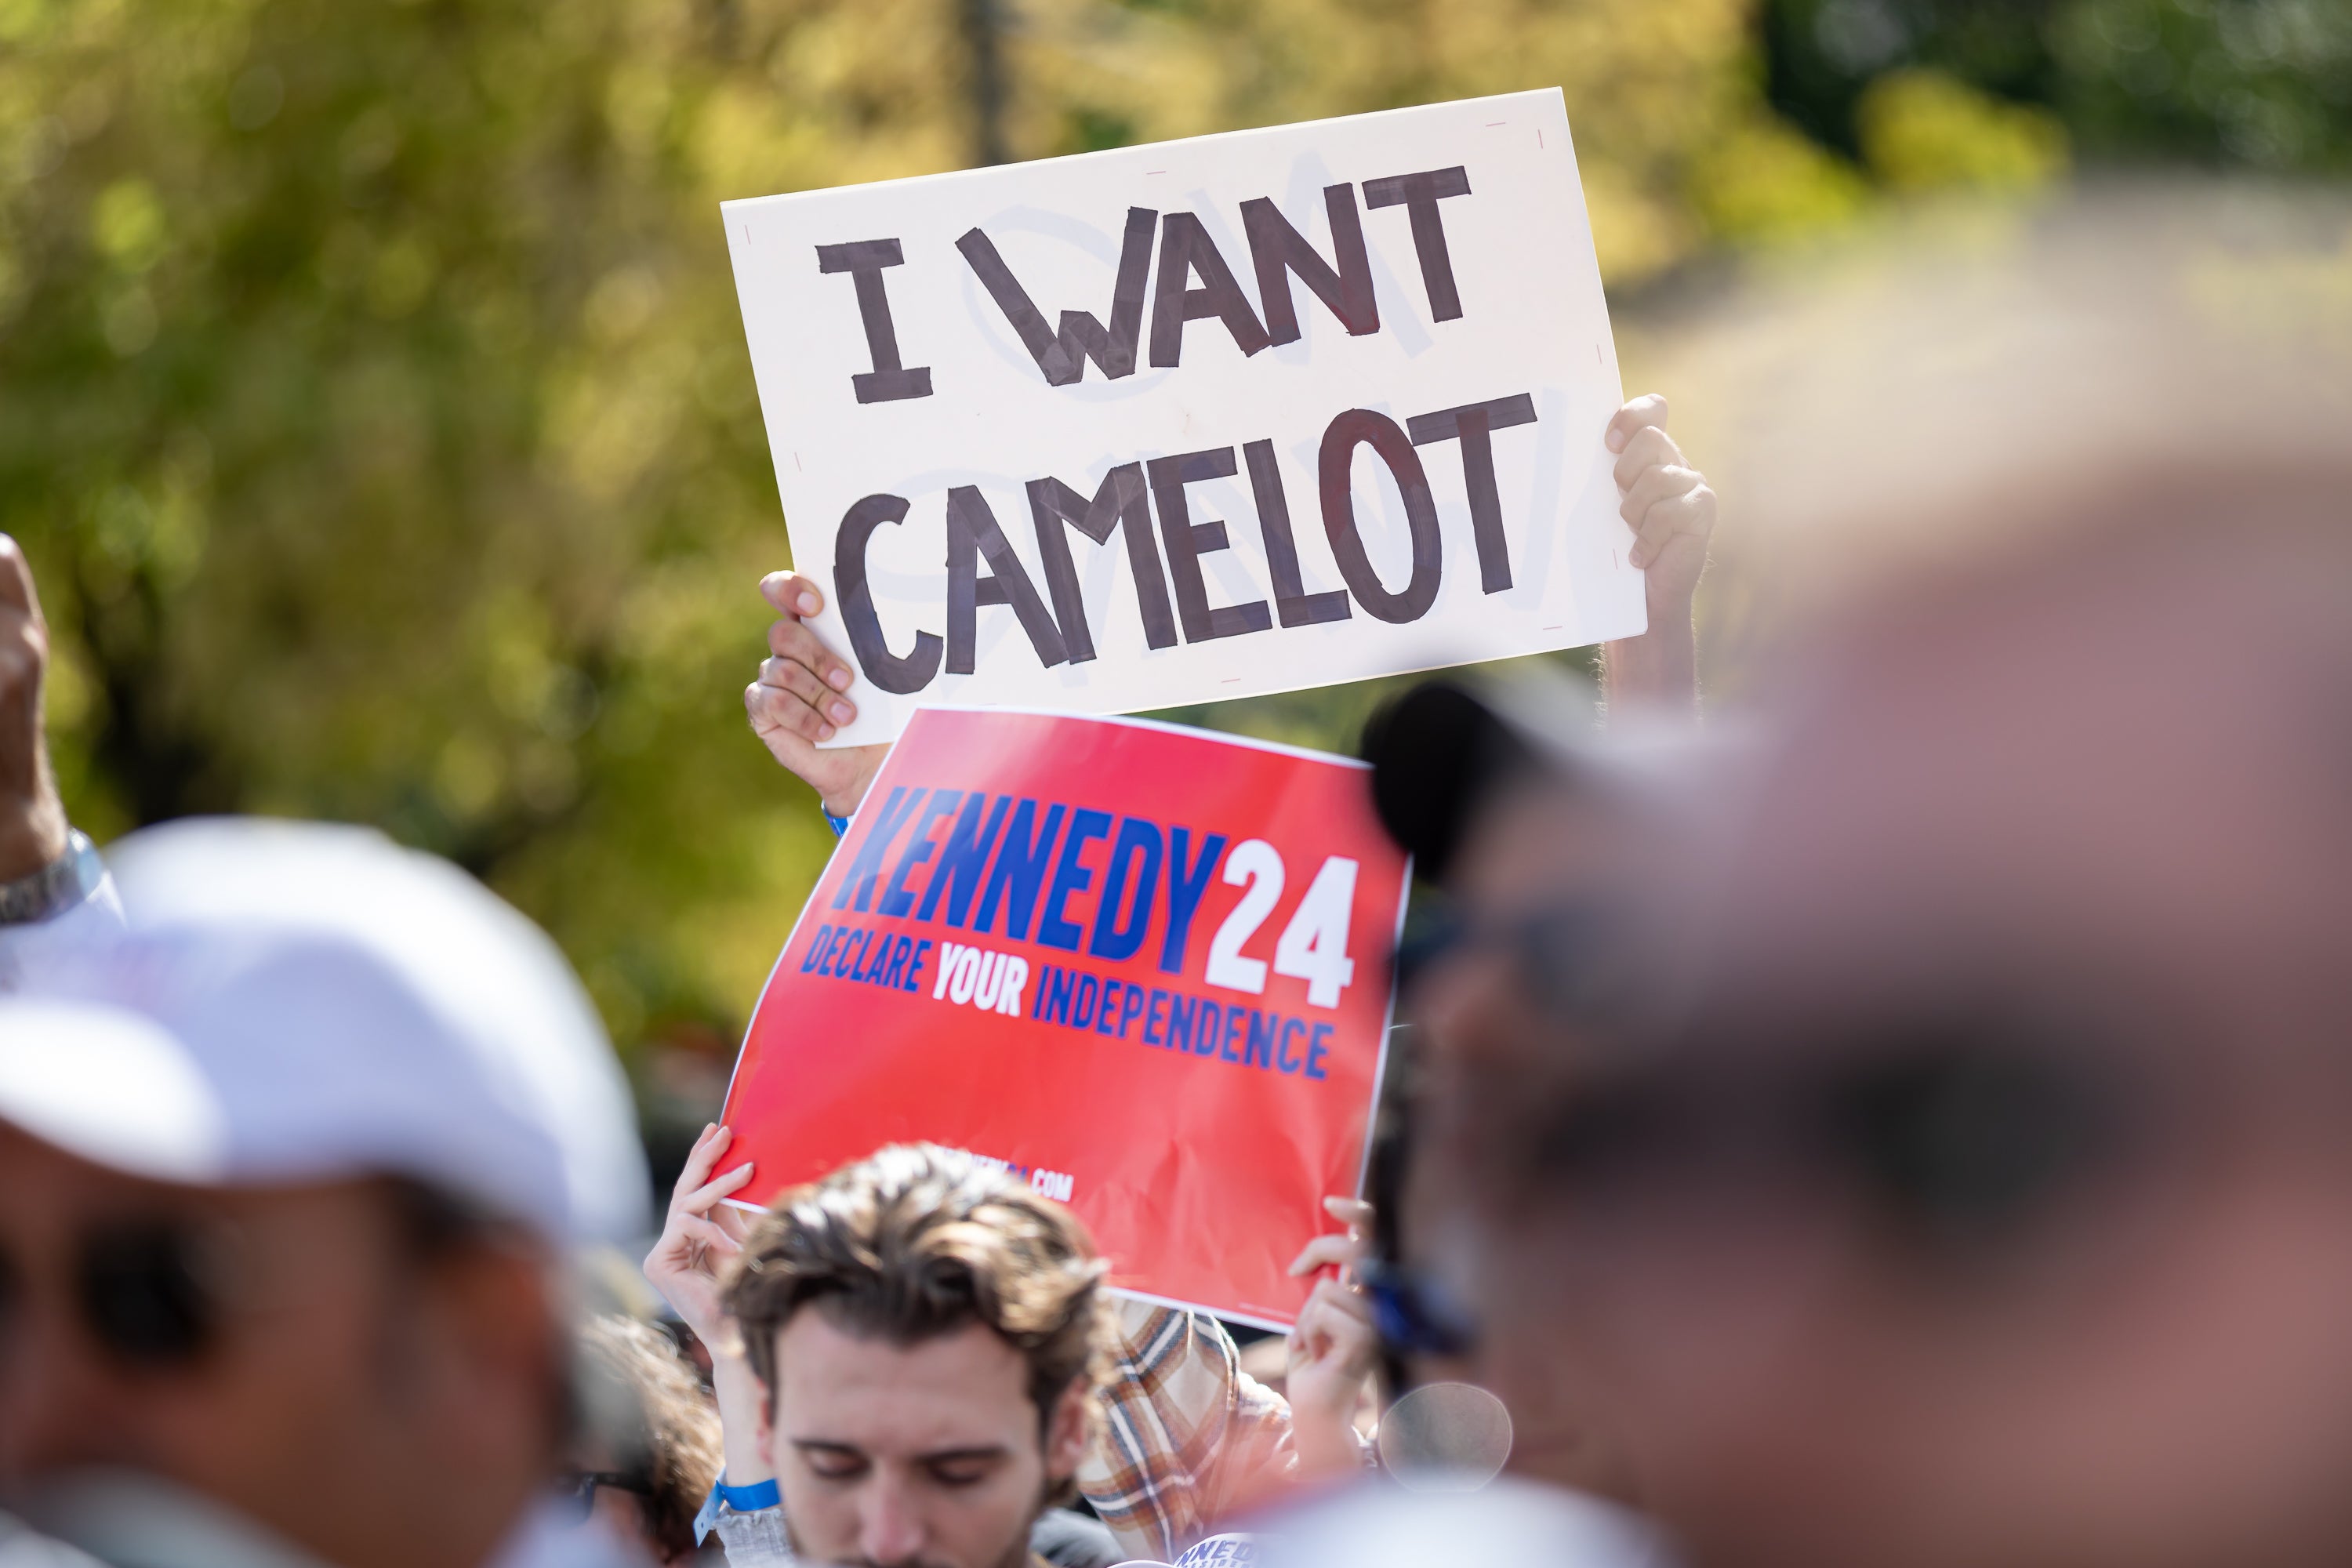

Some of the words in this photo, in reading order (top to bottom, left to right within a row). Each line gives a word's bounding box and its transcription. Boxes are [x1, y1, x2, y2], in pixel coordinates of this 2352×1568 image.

[815, 238, 933, 404] I
[956, 165, 1472, 386] WANT
[833, 393, 1537, 694] CAMELOT
[800, 924, 932, 993] DECLARE
[933, 942, 1029, 1017] YOUR
[1032, 964, 1335, 1080] INDEPENDENCE
